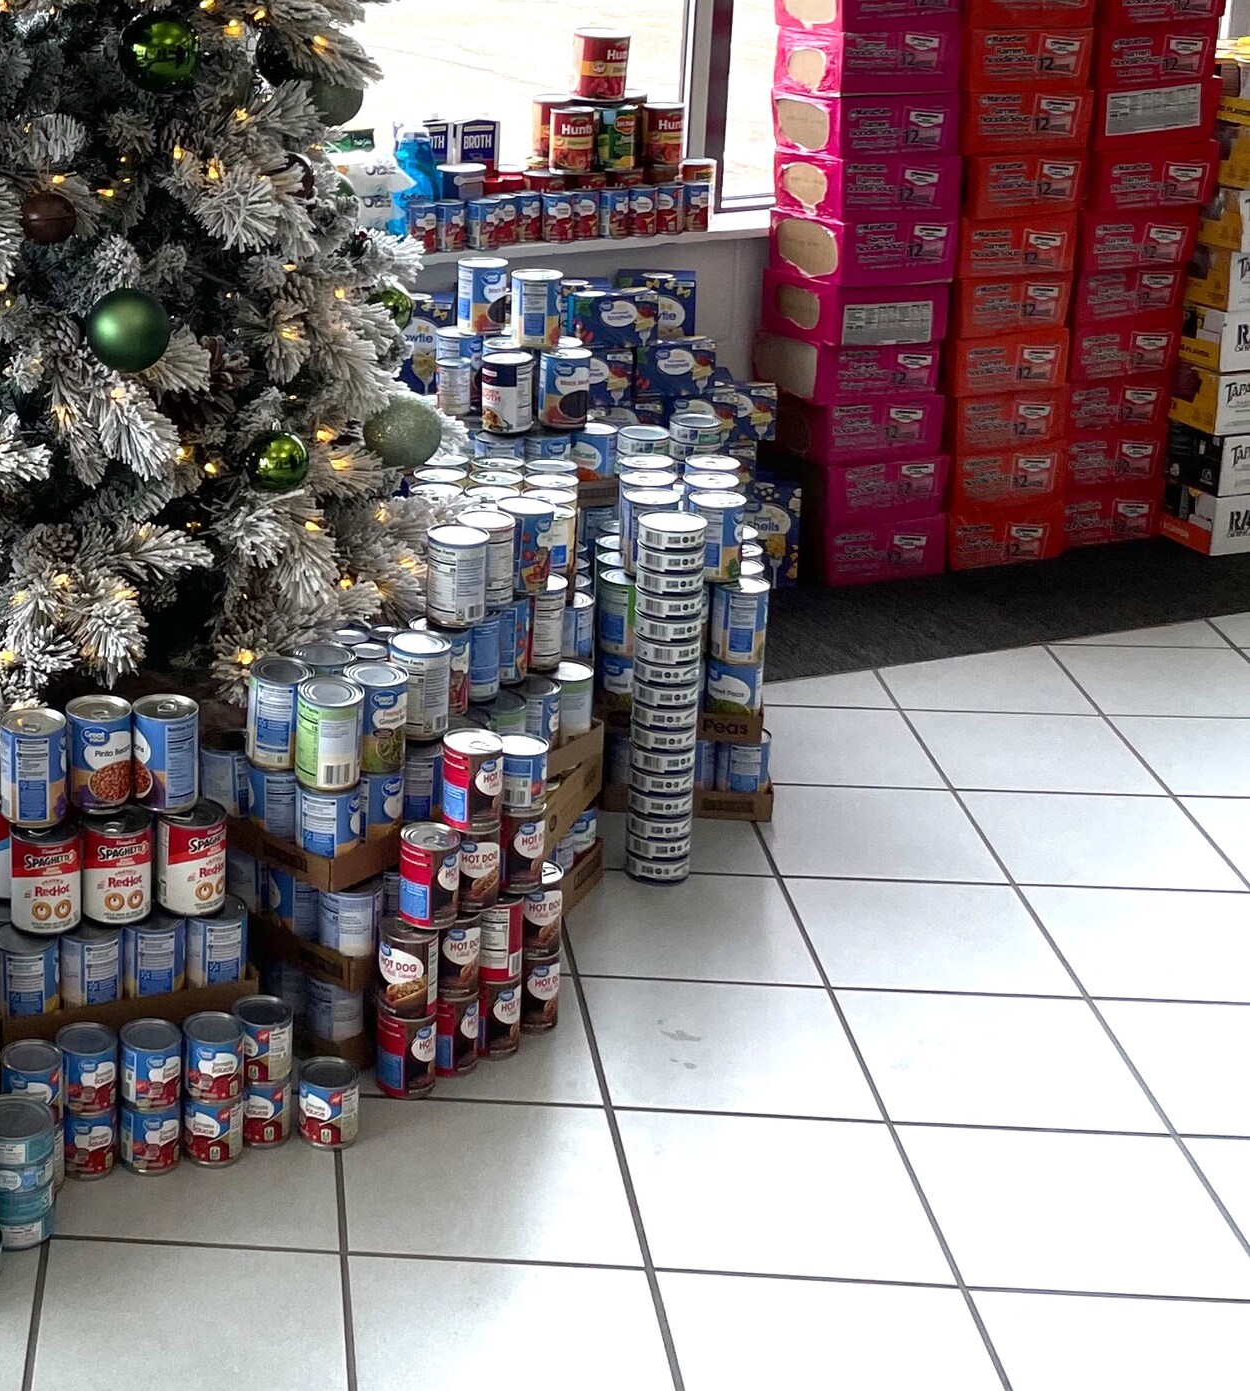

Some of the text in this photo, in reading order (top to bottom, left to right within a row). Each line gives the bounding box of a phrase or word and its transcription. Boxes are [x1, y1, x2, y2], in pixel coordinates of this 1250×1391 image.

[606, 49, 629, 61] Hun
[430, 134, 445, 150] OTH
[463, 134, 493, 150] BROTH
[403, 333, 434, 345] owtie
[702, 718, 748, 736] Peas
[94, 748, 114, 758] Pinto
[483, 773, 499, 784] HOT
[521, 836, 537, 846] HOT
[461, 853, 480, 863] HOT
[445, 868, 458, 879] HO
[108, 874, 143, 889] RedHot
[34, 884, 70, 898] RedHot
[528, 903, 547, 913] HOT
[450, 940, 468, 951] HOT
[395, 962, 417, 973] DOG
[534, 977, 552, 988] HOT
[500, 1001, 517, 1013] HOT
[418, 1039, 433, 1050] HOT
